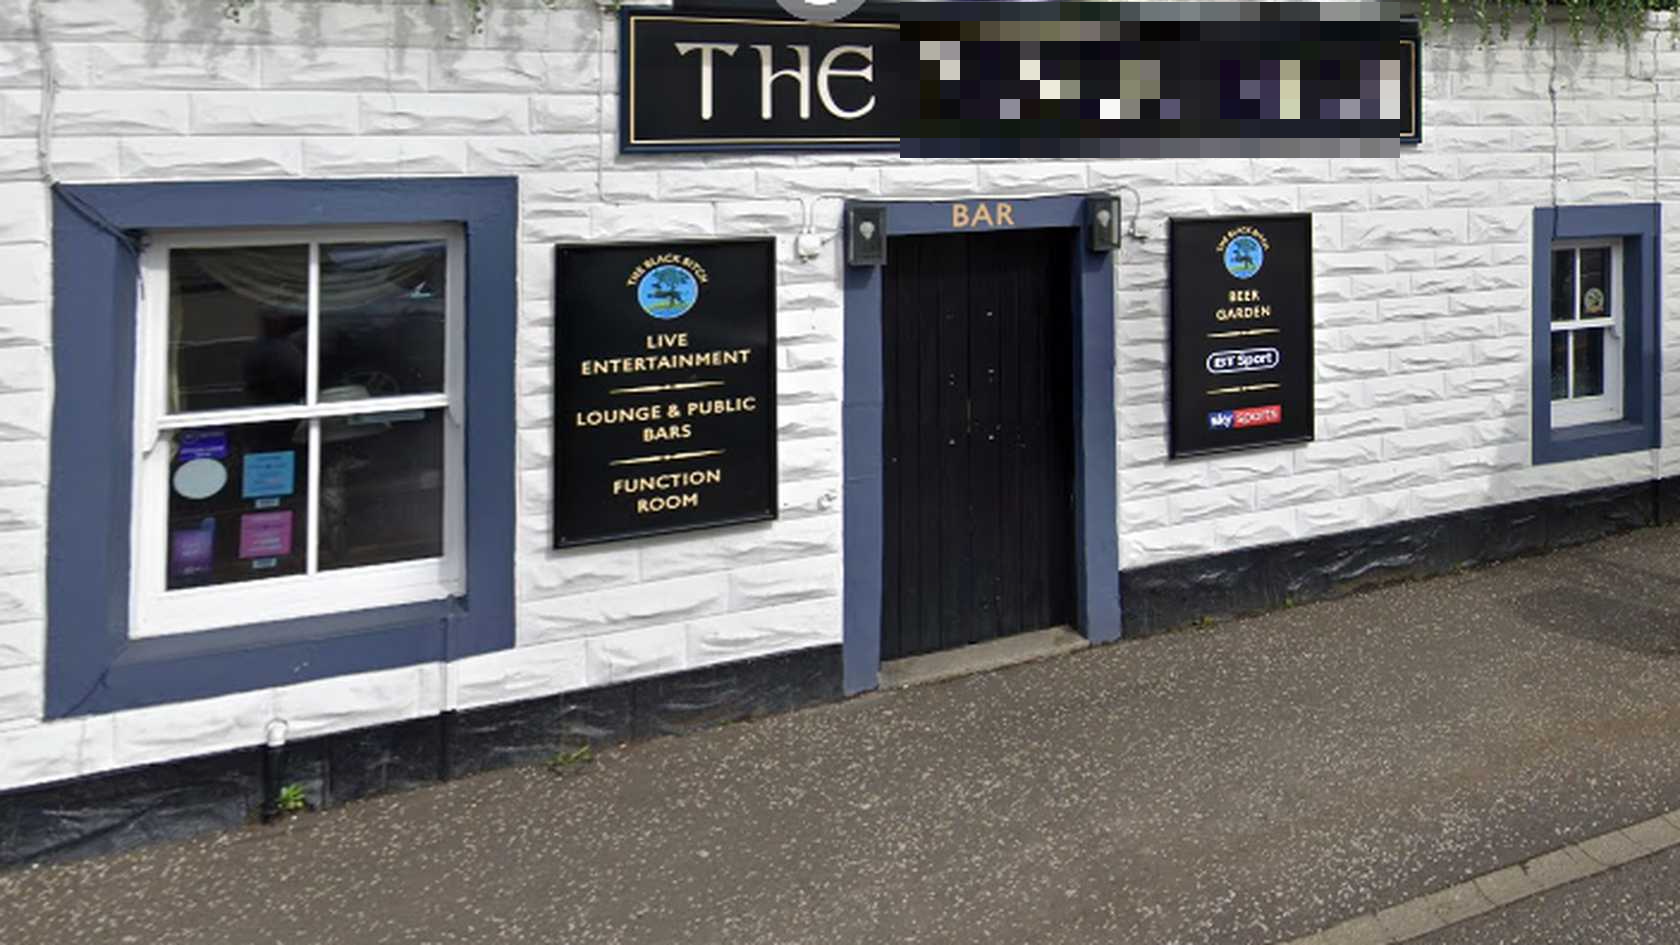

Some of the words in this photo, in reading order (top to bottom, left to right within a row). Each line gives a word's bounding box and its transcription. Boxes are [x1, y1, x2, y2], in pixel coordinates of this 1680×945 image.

[674, 42, 876, 120] THE
[952, 203, 1015, 228] BAR
[626, 265, 646, 286] THE
[644, 253, 681, 268] BLACK
[682, 257, 708, 283] BITCH
[1228, 289, 1261, 302] BEER
[1215, 305, 1272, 321] GARDEN
[646, 333, 688, 349] LIVE
[581, 349, 751, 375] ENTERTAINMENT
[1214, 355, 1236, 368] BT
[1237, 352, 1273, 370] Sport
[576, 404, 661, 426] LOUNGE
[668, 403, 681, 418] &
[687, 396, 756, 416] PUBLIC
[643, 423, 692, 442] BARS
[613, 469, 721, 494] FUNCTION
[637, 493, 699, 514] ROOM
